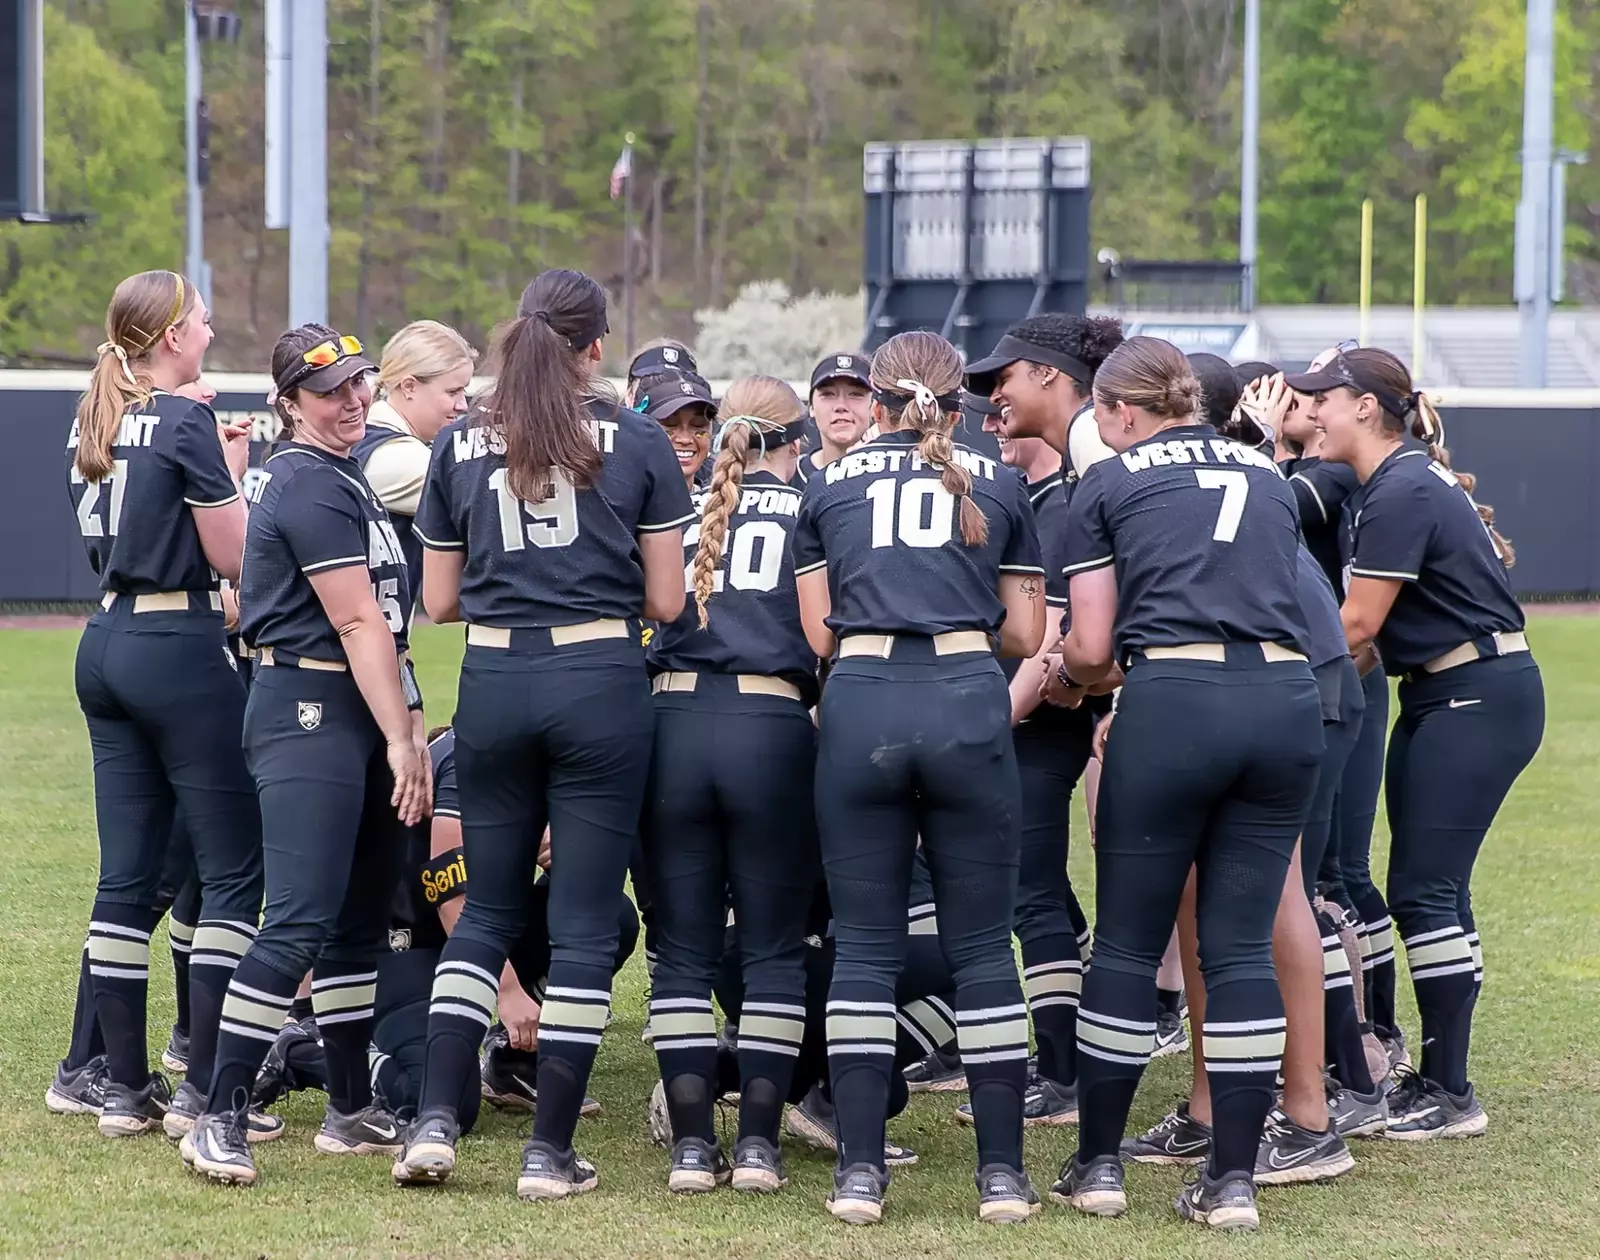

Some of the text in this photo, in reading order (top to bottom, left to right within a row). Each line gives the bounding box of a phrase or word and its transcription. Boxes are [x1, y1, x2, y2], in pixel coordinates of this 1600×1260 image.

[825, 450, 906, 486] WEST
[1120, 439, 1208, 474] WEST
[71, 459, 128, 537] 27
[487, 464, 579, 552] 19
[737, 489, 803, 518] POIN
[866, 477, 955, 549] 10
[1194, 469, 1249, 543] 7
[421, 854, 467, 903] Seni
